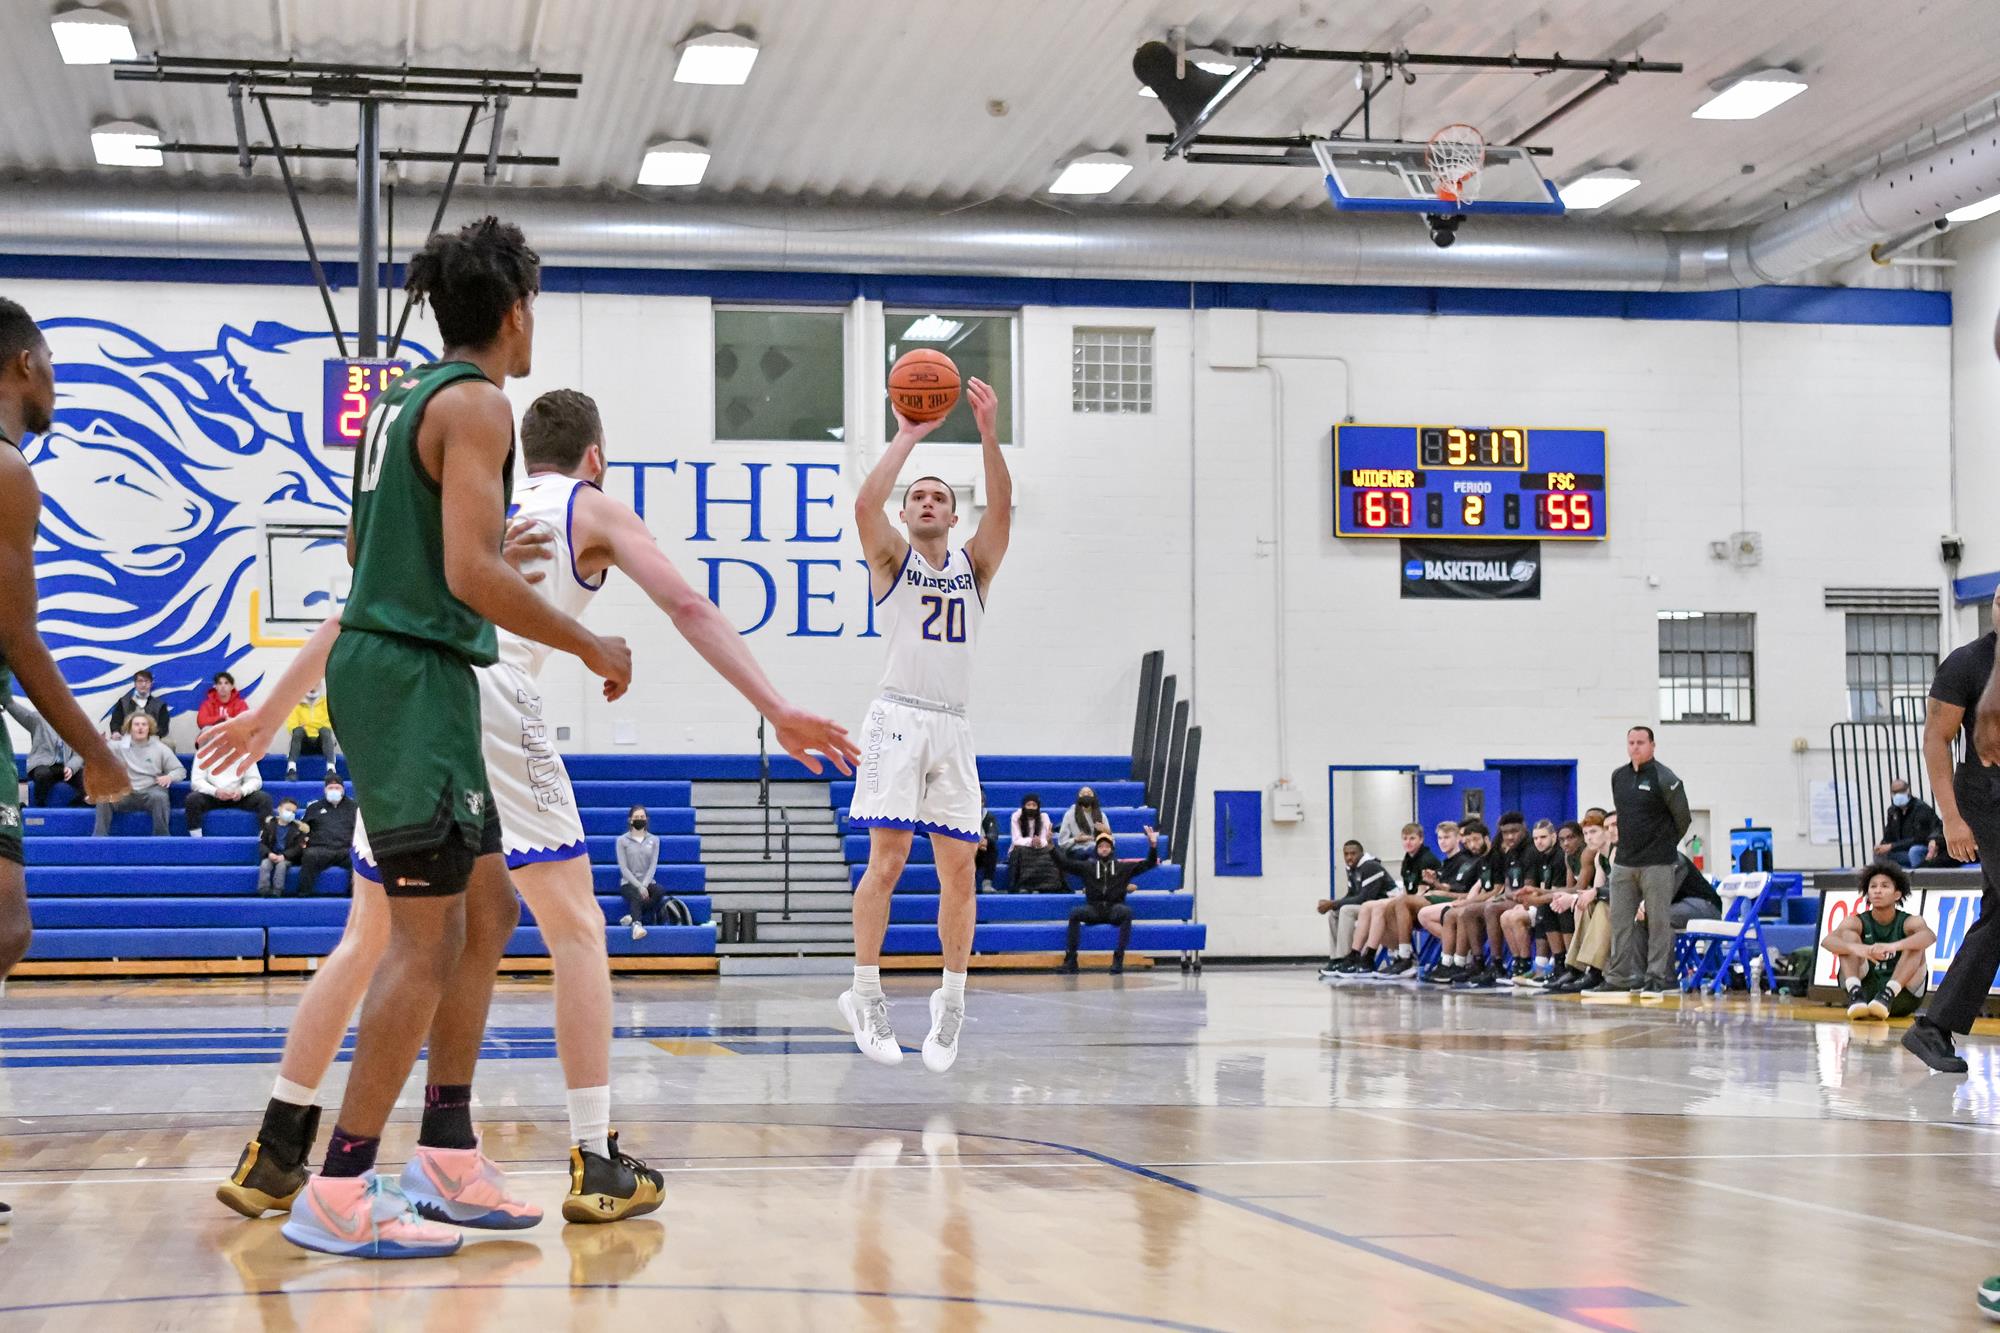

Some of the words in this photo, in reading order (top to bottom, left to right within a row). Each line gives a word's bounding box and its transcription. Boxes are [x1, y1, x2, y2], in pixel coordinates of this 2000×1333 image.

[1447, 429, 1522, 465] 3:17
[1352, 469, 1415, 488] WIDENER
[1453, 482, 1492, 494] PERIOD
[1547, 472, 1576, 491] FSC
[607, 459, 843, 543] THE
[1365, 491, 1409, 527] 67
[1464, 495, 1482, 526] 2
[1547, 493, 1591, 530] 55
[906, 569, 973, 594] WIDENER
[1424, 560, 1510, 581] BASKETBALL
[921, 595, 967, 643] 20
[516, 688, 569, 813] PRIDE
